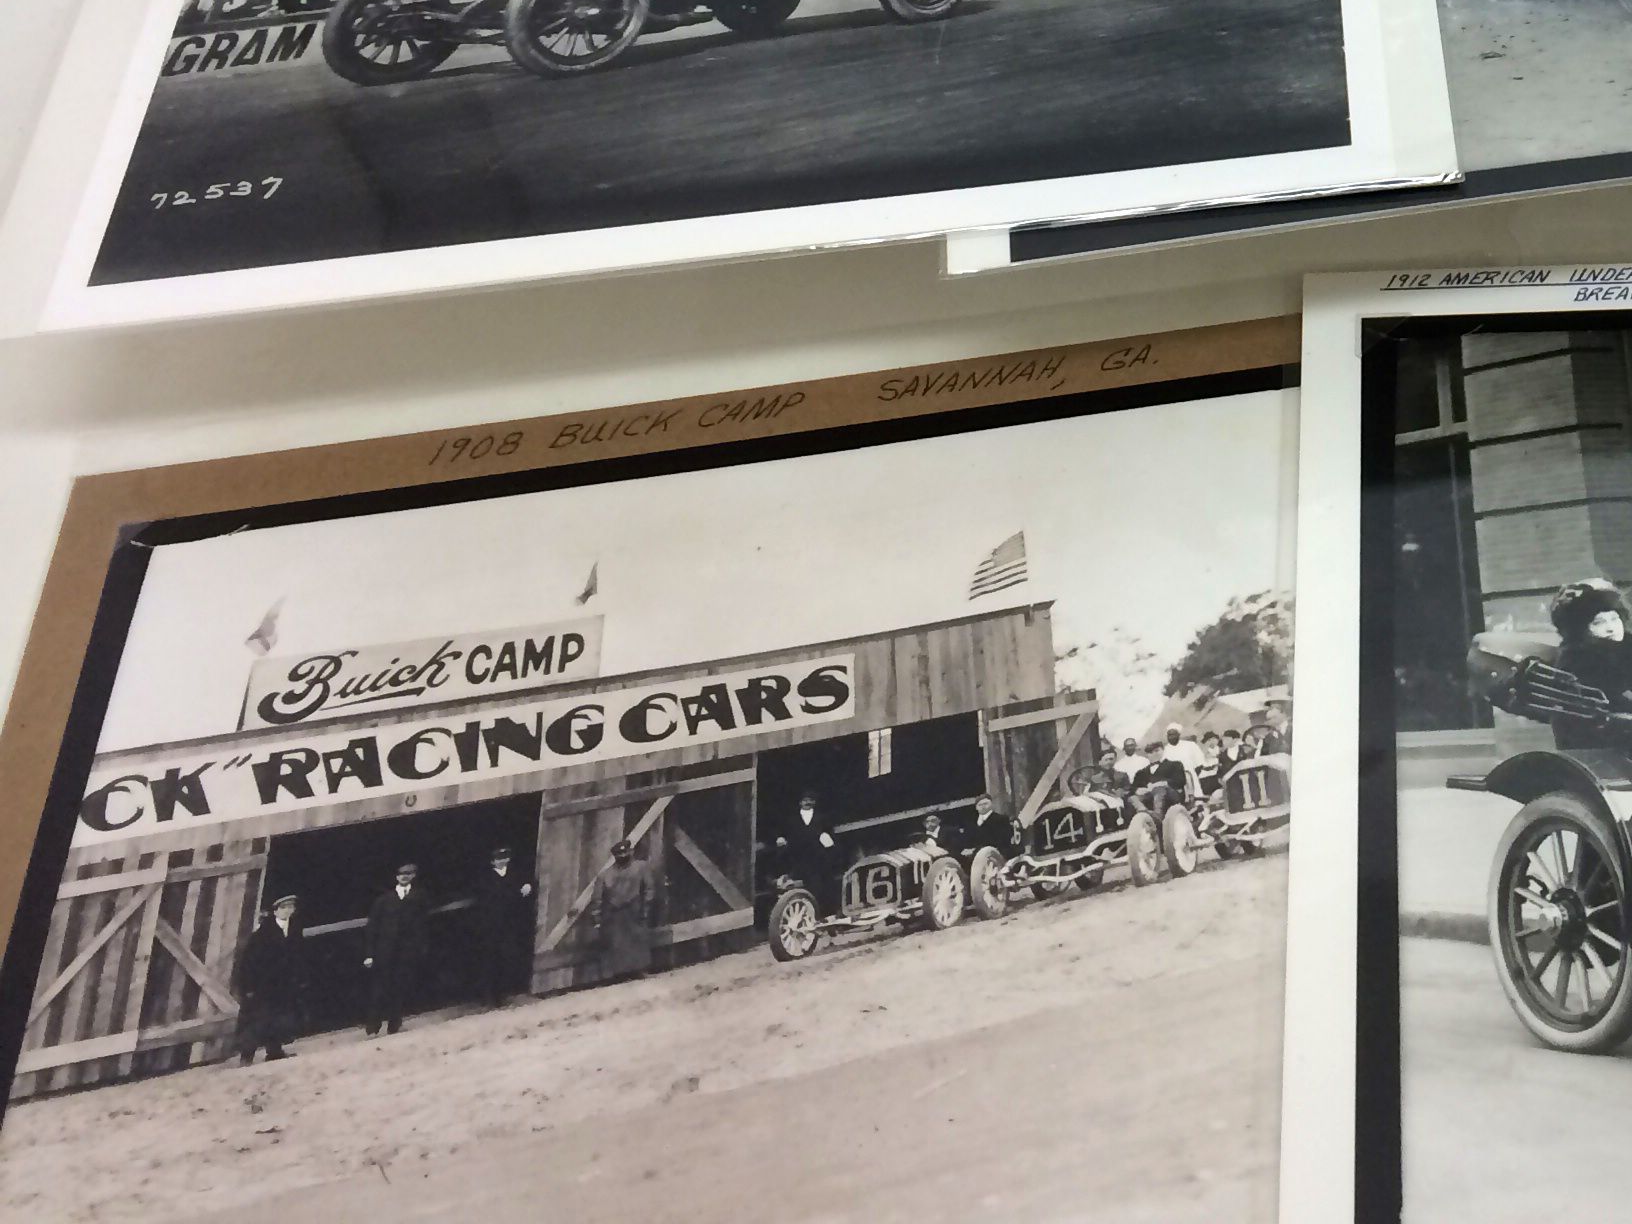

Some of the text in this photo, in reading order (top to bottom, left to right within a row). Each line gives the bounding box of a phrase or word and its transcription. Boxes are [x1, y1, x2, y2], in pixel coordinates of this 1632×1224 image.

[164, 21, 317, 77] GRAM
[150, 176, 284, 210] 72537
[1386, 273, 1430, 289] 1912
[1438, 269, 1552, 287] AMERICAN
[429, 343, 1159, 466] 1908 BUICK CAMP SAVANNAH, GA.
[257, 632, 585, 725] Buick CAMP
[250, 703, 607, 805] RACING
[618, 664, 852, 742] CARS
[1240, 768, 1271, 810] 11
[1041, 812, 1084, 851] 14
[845, 867, 894, 909] 16
